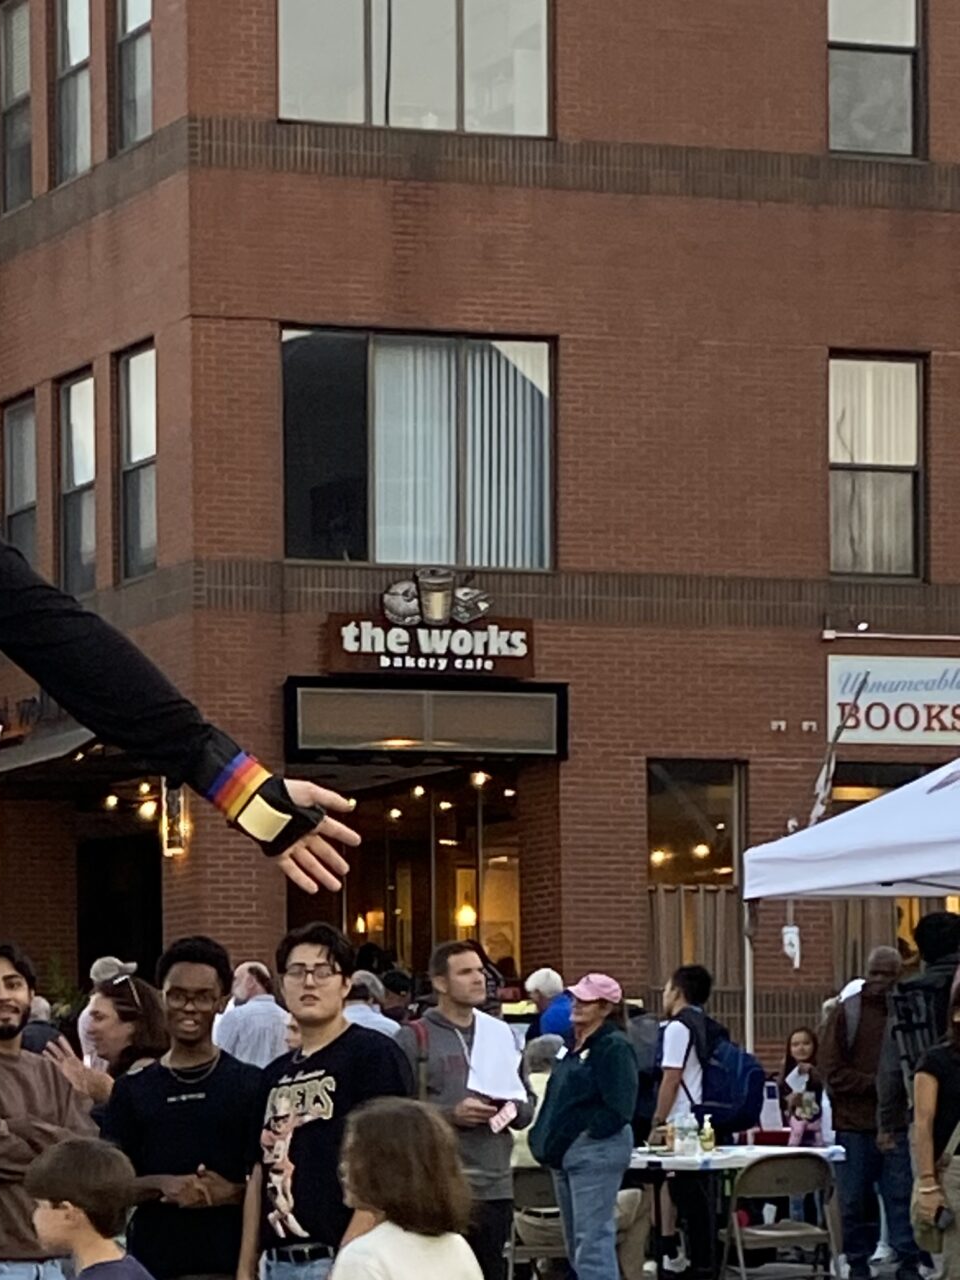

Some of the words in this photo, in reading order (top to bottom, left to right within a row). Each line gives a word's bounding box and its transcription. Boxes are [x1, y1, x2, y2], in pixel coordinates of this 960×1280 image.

[341, 621, 410, 654] the
[417, 625, 528, 657] works
[380, 655, 449, 671] bakery
[454, 658, 494, 671] cafe
[838, 668, 960, 695] Unameabl
